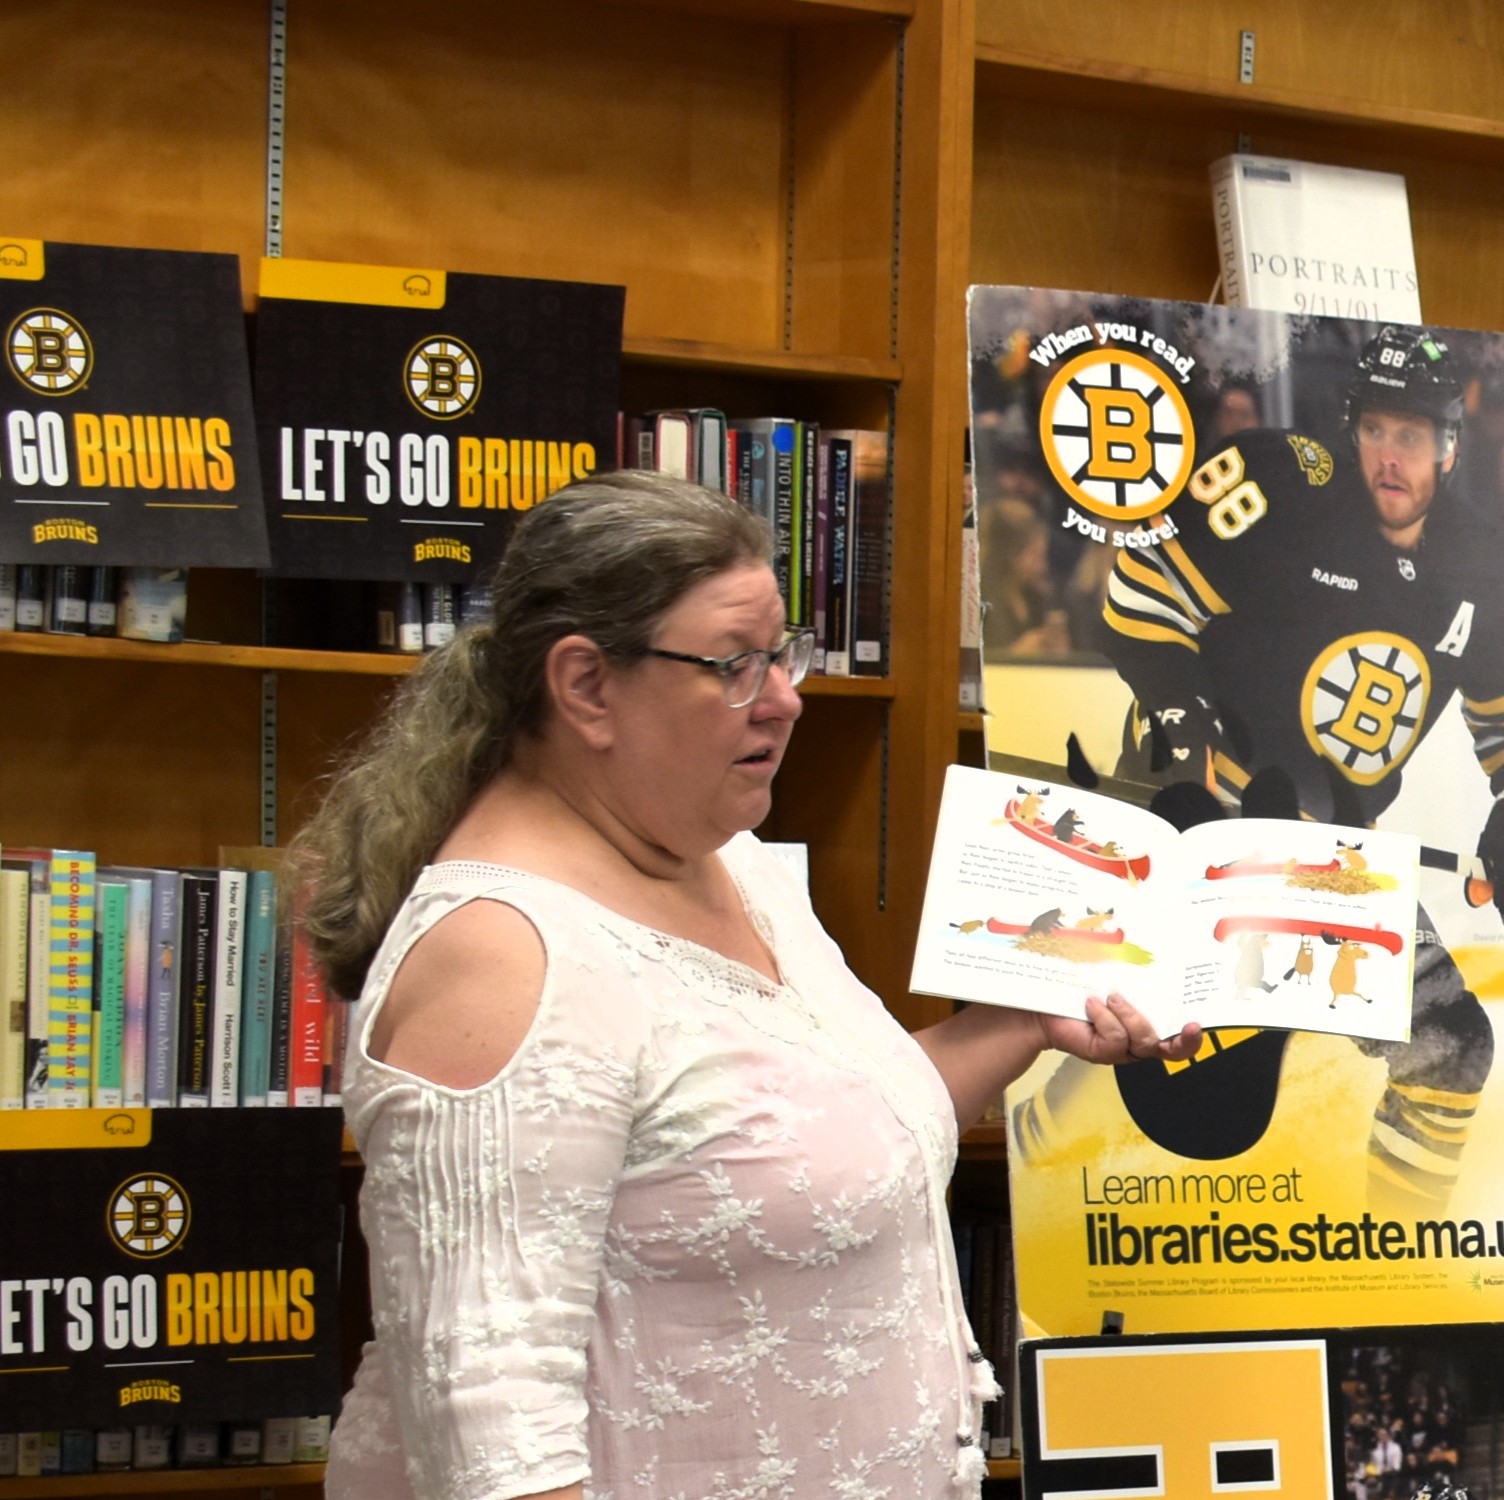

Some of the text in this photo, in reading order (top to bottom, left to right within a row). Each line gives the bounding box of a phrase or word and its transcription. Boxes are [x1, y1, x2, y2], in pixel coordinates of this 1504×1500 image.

[1217, 188, 1241, 308] PORTRAIT
[1251, 252, 1417, 292] PORTRAITS
[1294, 293, 1380, 321] 9/11/01
[30, 325, 70, 376] B
[425, 355, 458, 400] B
[1029, 322, 1195, 383] When you read,
[1380, 348, 1406, 368] 88
[1370, 374, 1406, 388] BAUER
[8, 410, 235, 490] GO BRUINS
[1084, 388, 1152, 480] B
[281, 427, 596, 511] LET'S GO BRUINS
[1187, 446, 1267, 540] 88
[778, 453, 791, 555] INTO THIN AIR
[833, 449, 848, 584] PADDLE WATER
[1062, 507, 1179, 548] you score!
[33, 524, 98, 544] BRUINS
[414, 543, 471, 564] BRUINS
[1434, 601, 1475, 657] A
[1331, 659, 1406, 757] B
[65, 861, 80, 1077] BECOMING DR. SEUSS BRIAN JAY
[156, 888, 174, 1090] Tasha Brian Morton
[193, 887, 211, 1091] James Patterson by James Patterson
[223, 881, 239, 1091] How to Stay Married Harrison Scott
[304, 1022, 320, 1063] wild
[134, 1192, 168, 1238] B
[1083, 1167, 1303, 1205] Learn more at
[0, 1268, 315, 1354] ET'S GO BRUINS
[119, 1385, 181, 1406] BRUINS
